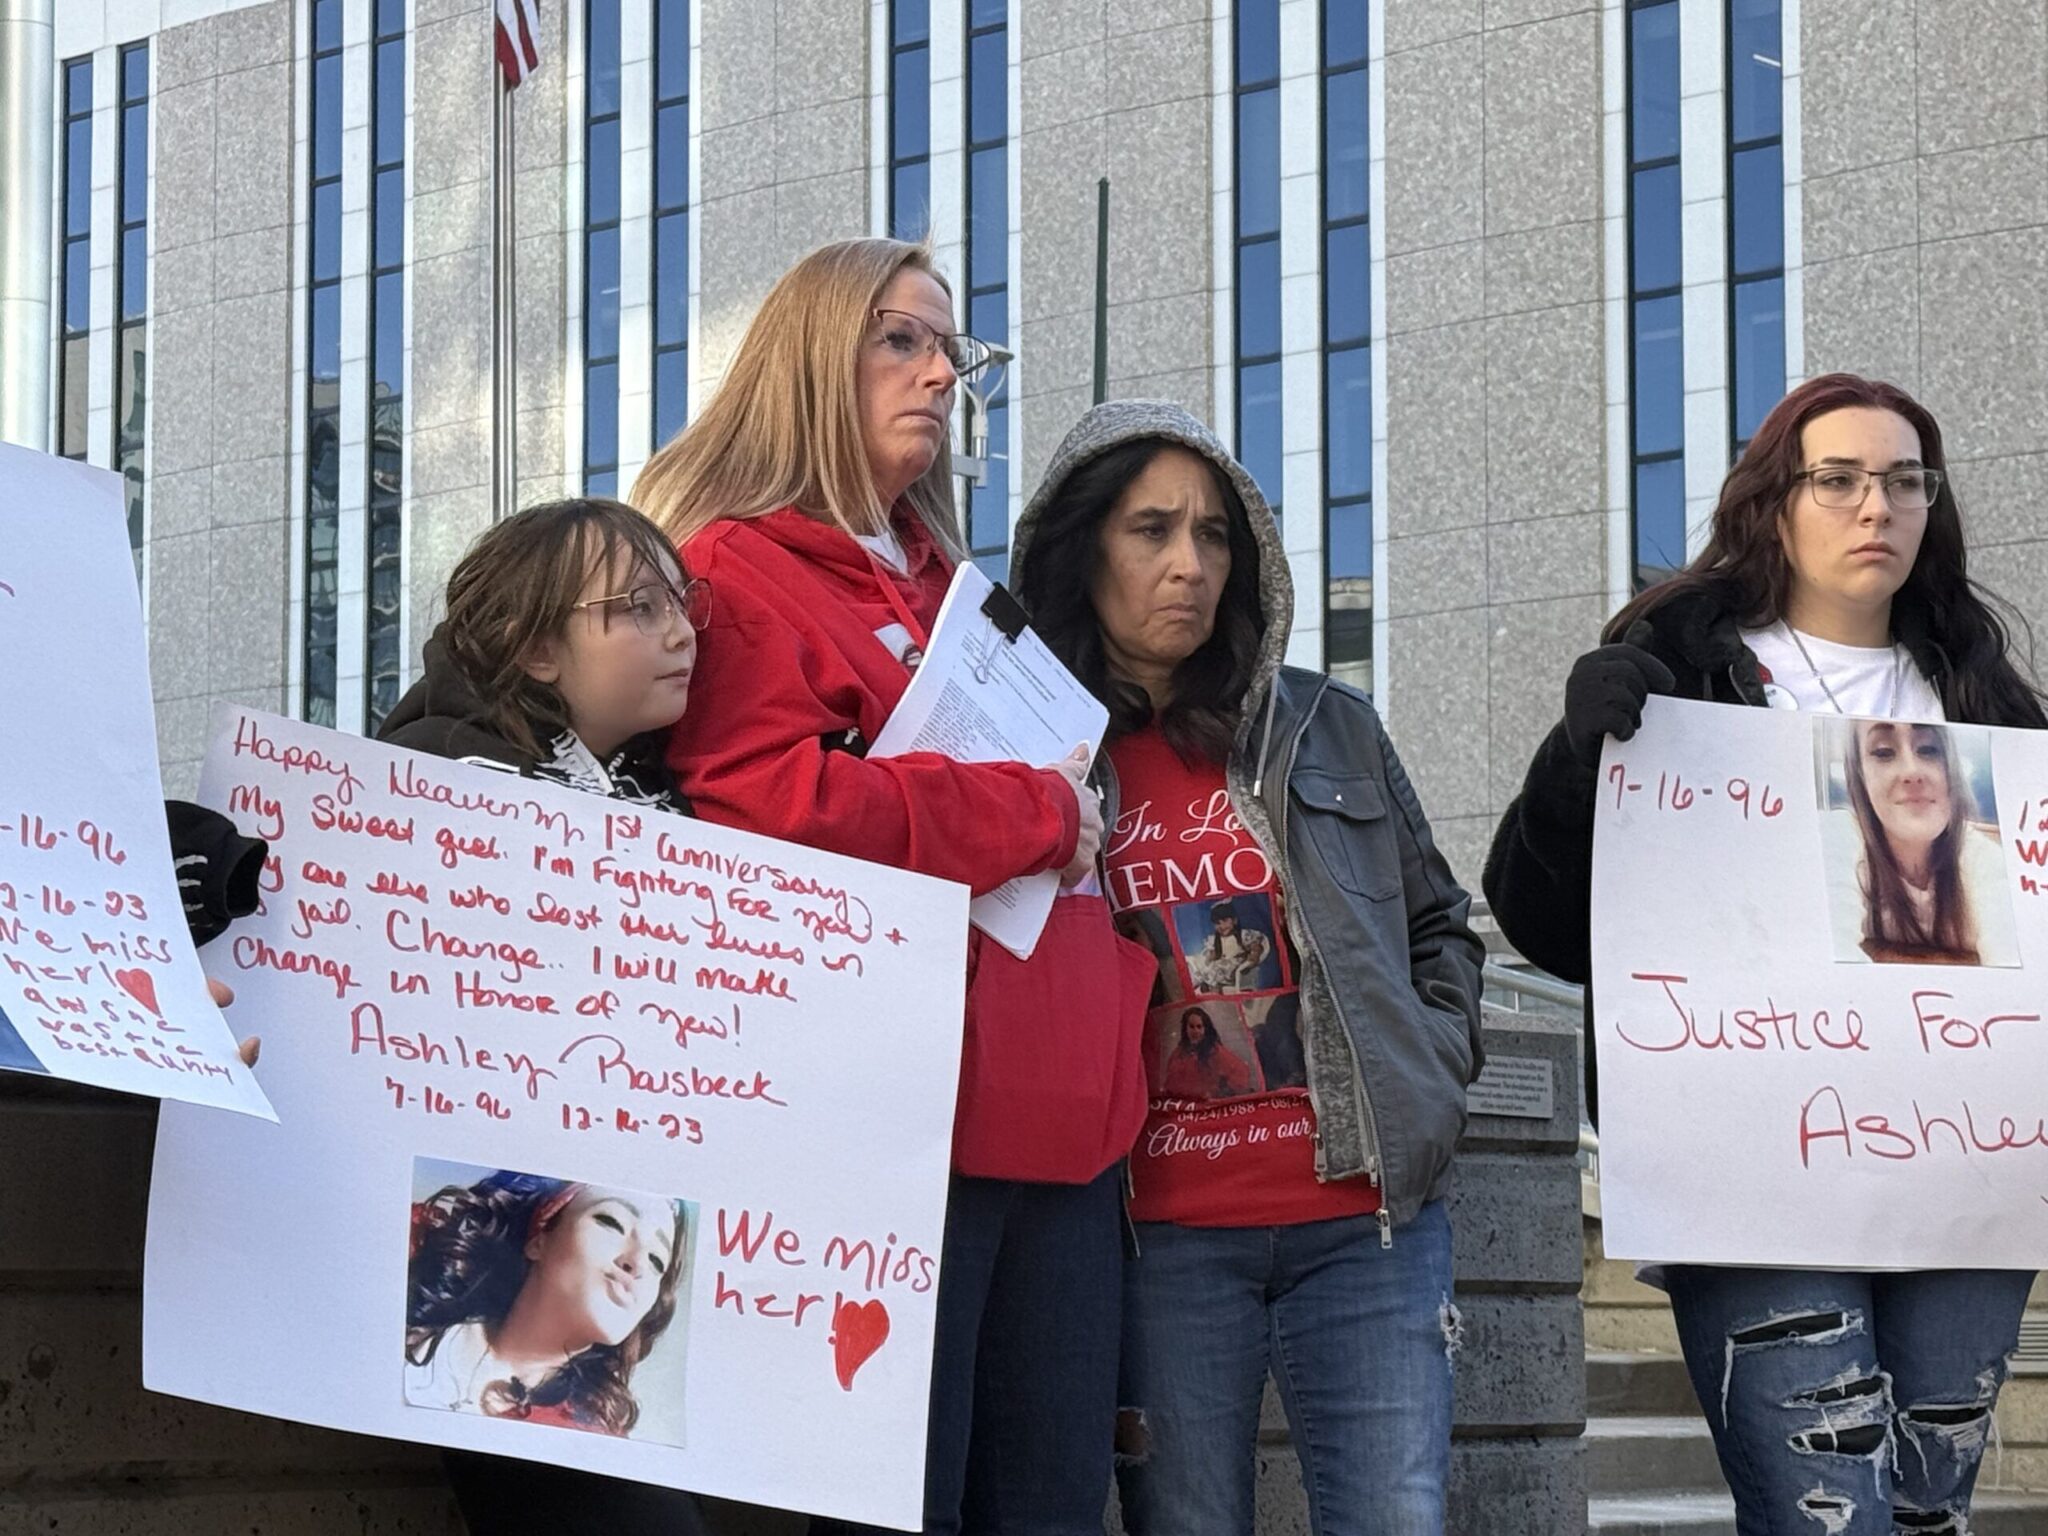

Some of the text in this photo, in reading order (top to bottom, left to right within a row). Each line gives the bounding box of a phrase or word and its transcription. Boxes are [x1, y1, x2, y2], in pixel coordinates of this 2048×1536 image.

[233, 716, 364, 805] Happy
[229, 784, 284, 841] My
[1609, 764, 1784, 820] 7-16-96
[0, 813, 127, 866] -16-96
[1104, 801, 1168, 857] In
[0, 882, 148, 922] 2-16-23
[450, 885, 511, 915] who
[1106, 847, 1273, 914] EMO
[81, 930, 173, 964] miss
[592, 946, 601, 975] I
[233, 936, 361, 999] Change
[575, 990, 620, 1020] of
[1617, 973, 2040, 1053] Justice For
[350, 1002, 558, 1100] Ashley
[386, 1076, 511, 1120] 7-16-96
[1148, 1123, 1241, 1160] Always
[1248, 1123, 1270, 1143] in
[717, 1208, 935, 1293] We miss
